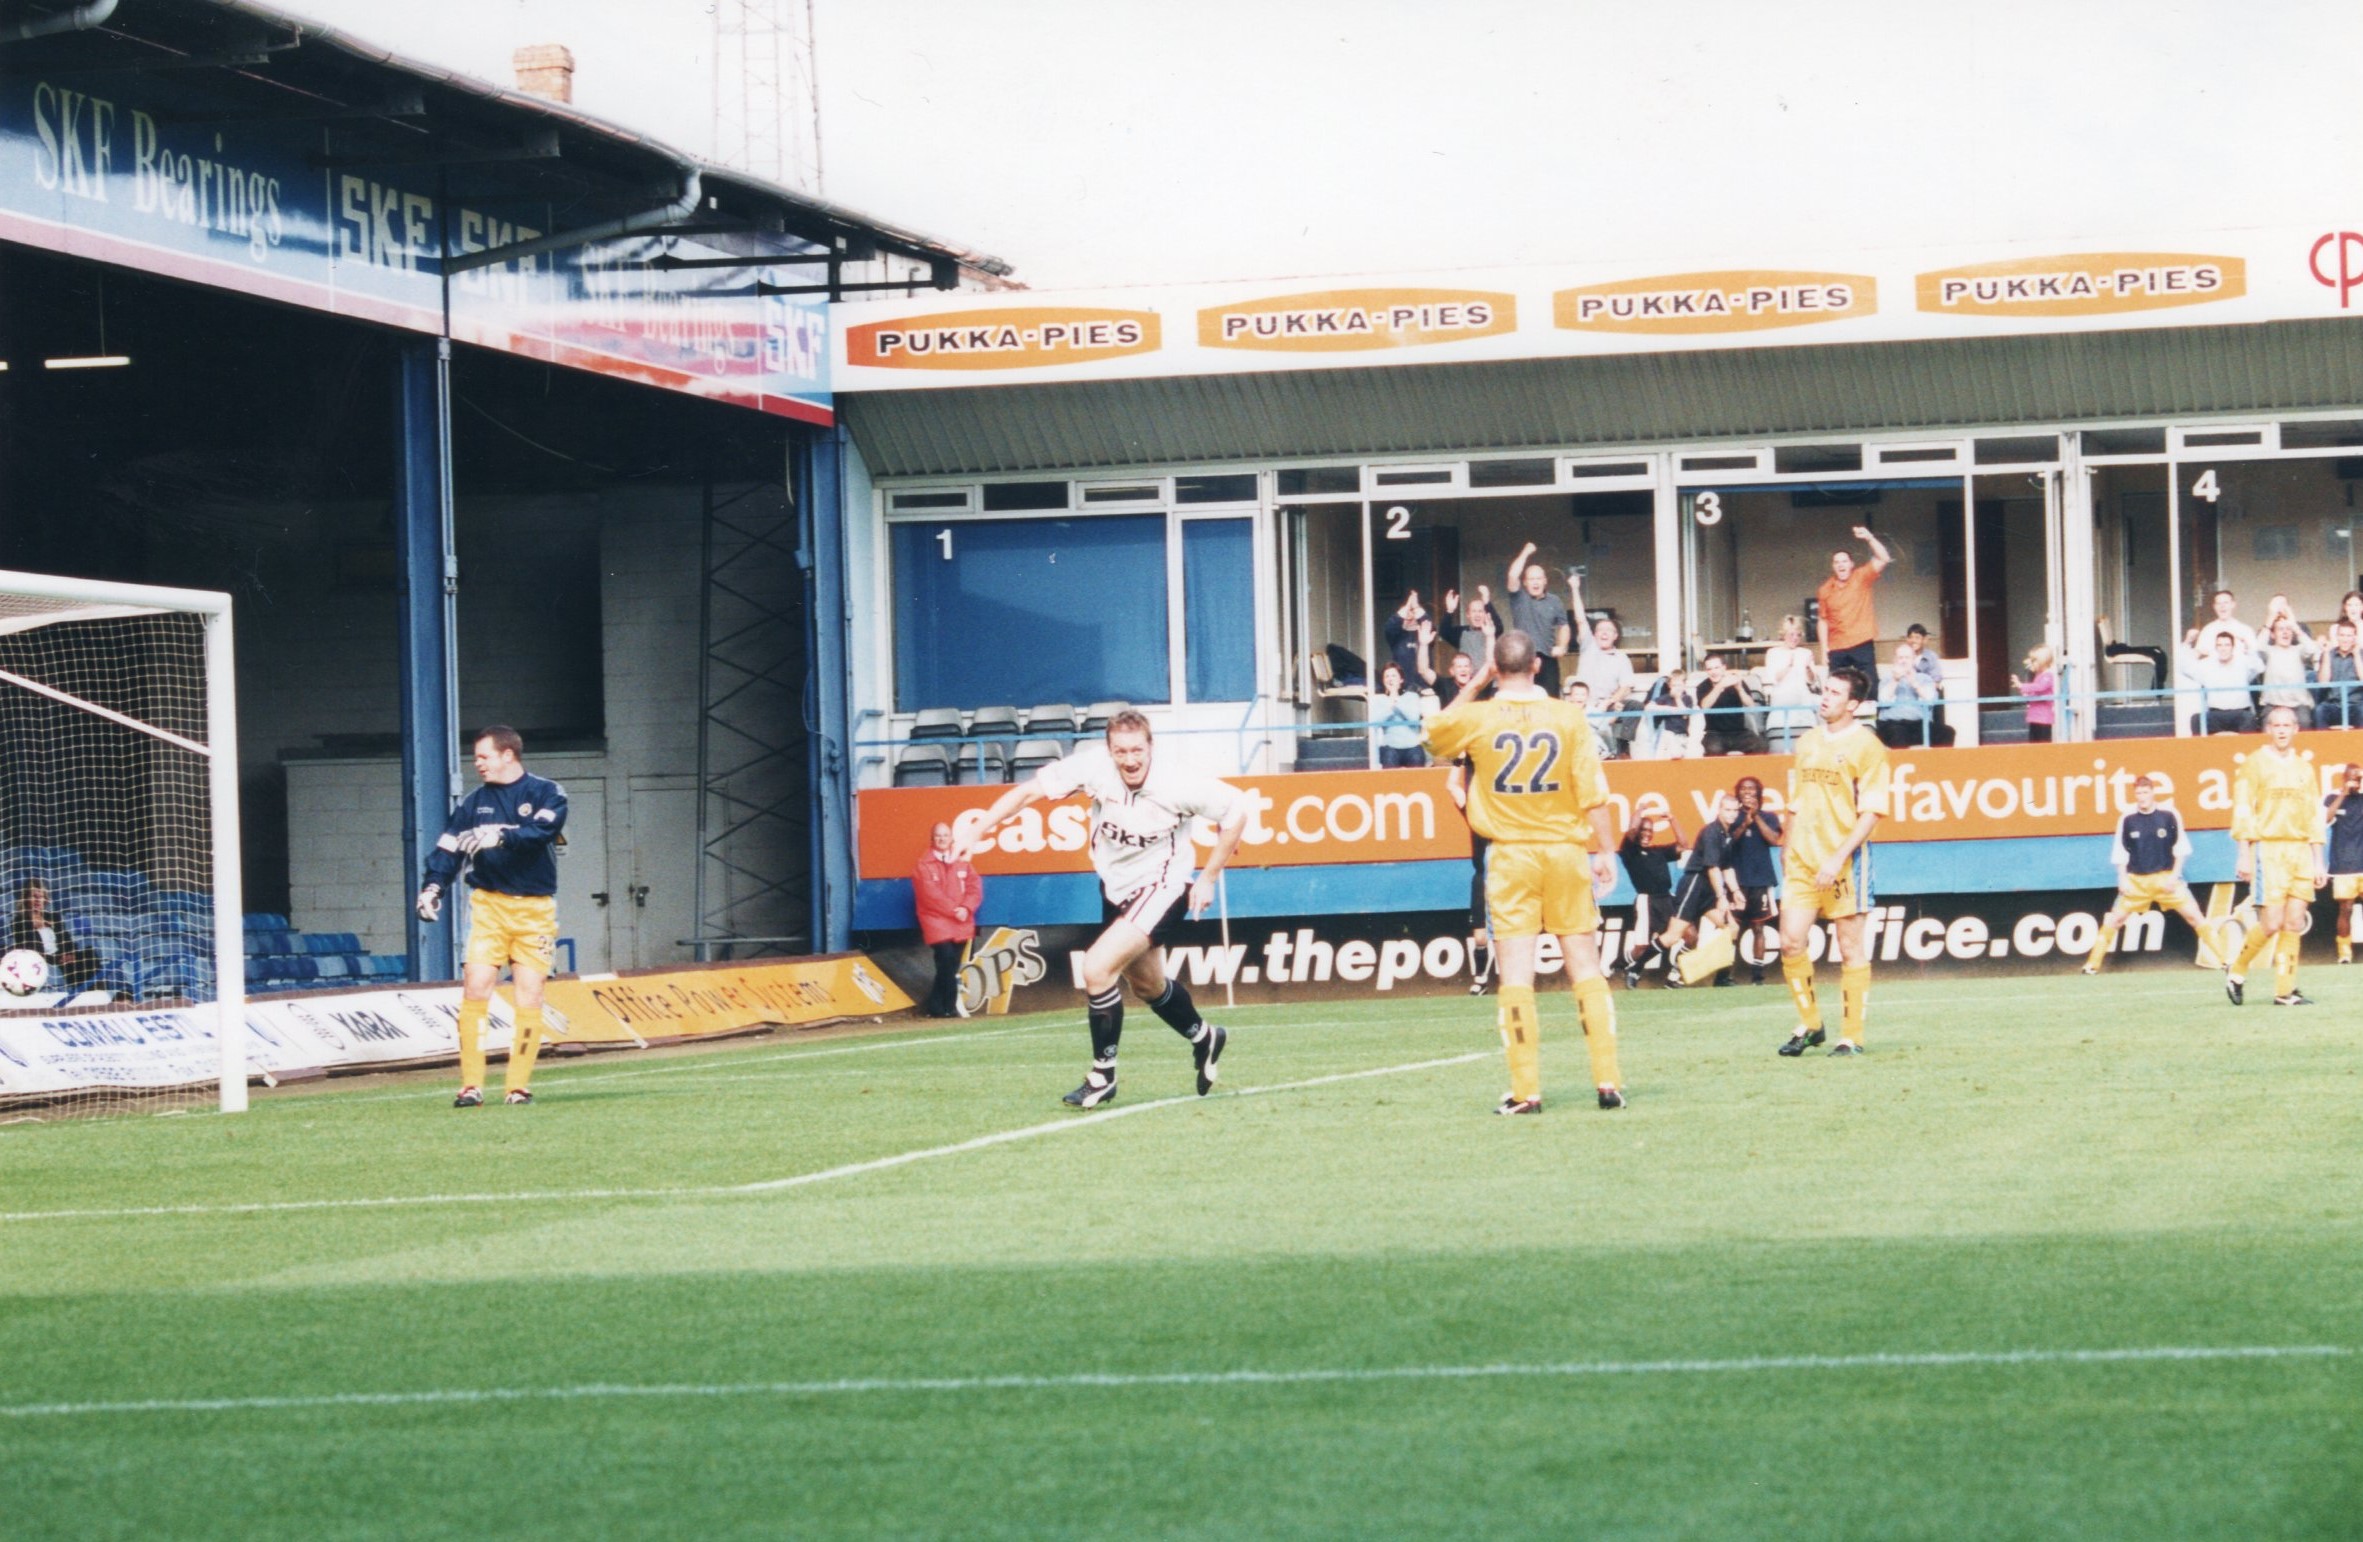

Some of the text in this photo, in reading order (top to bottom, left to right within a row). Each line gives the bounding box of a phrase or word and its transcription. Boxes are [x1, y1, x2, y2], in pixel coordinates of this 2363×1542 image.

[34, 82, 283, 263] SKF Bearings
[341, 174, 433, 277] SKF
[1580, 286, 1851, 321] PUKKA-PIES
[1943, 266, 2221, 304] PUKKA-PIES
[877, 320, 1143, 356] PUKKA-PIES
[1224, 302, 1492, 339] PUKKA-PIES
[765, 302, 825, 379] SKF
[2191, 470, 2221, 502] 4
[1386, 506, 1412, 539] 2
[1695, 492, 1722, 525] 3
[936, 529, 953, 561] 1
[1493, 731, 1560, 794] 22
[1889, 758, 2175, 823] favourite
[958, 932, 1046, 1012] OPS
[592, 984, 683, 1023] Office
[667, 982, 748, 1015] Power
[739, 977, 837, 1020] Systems
[41, 1018, 146, 1047] COMAU
